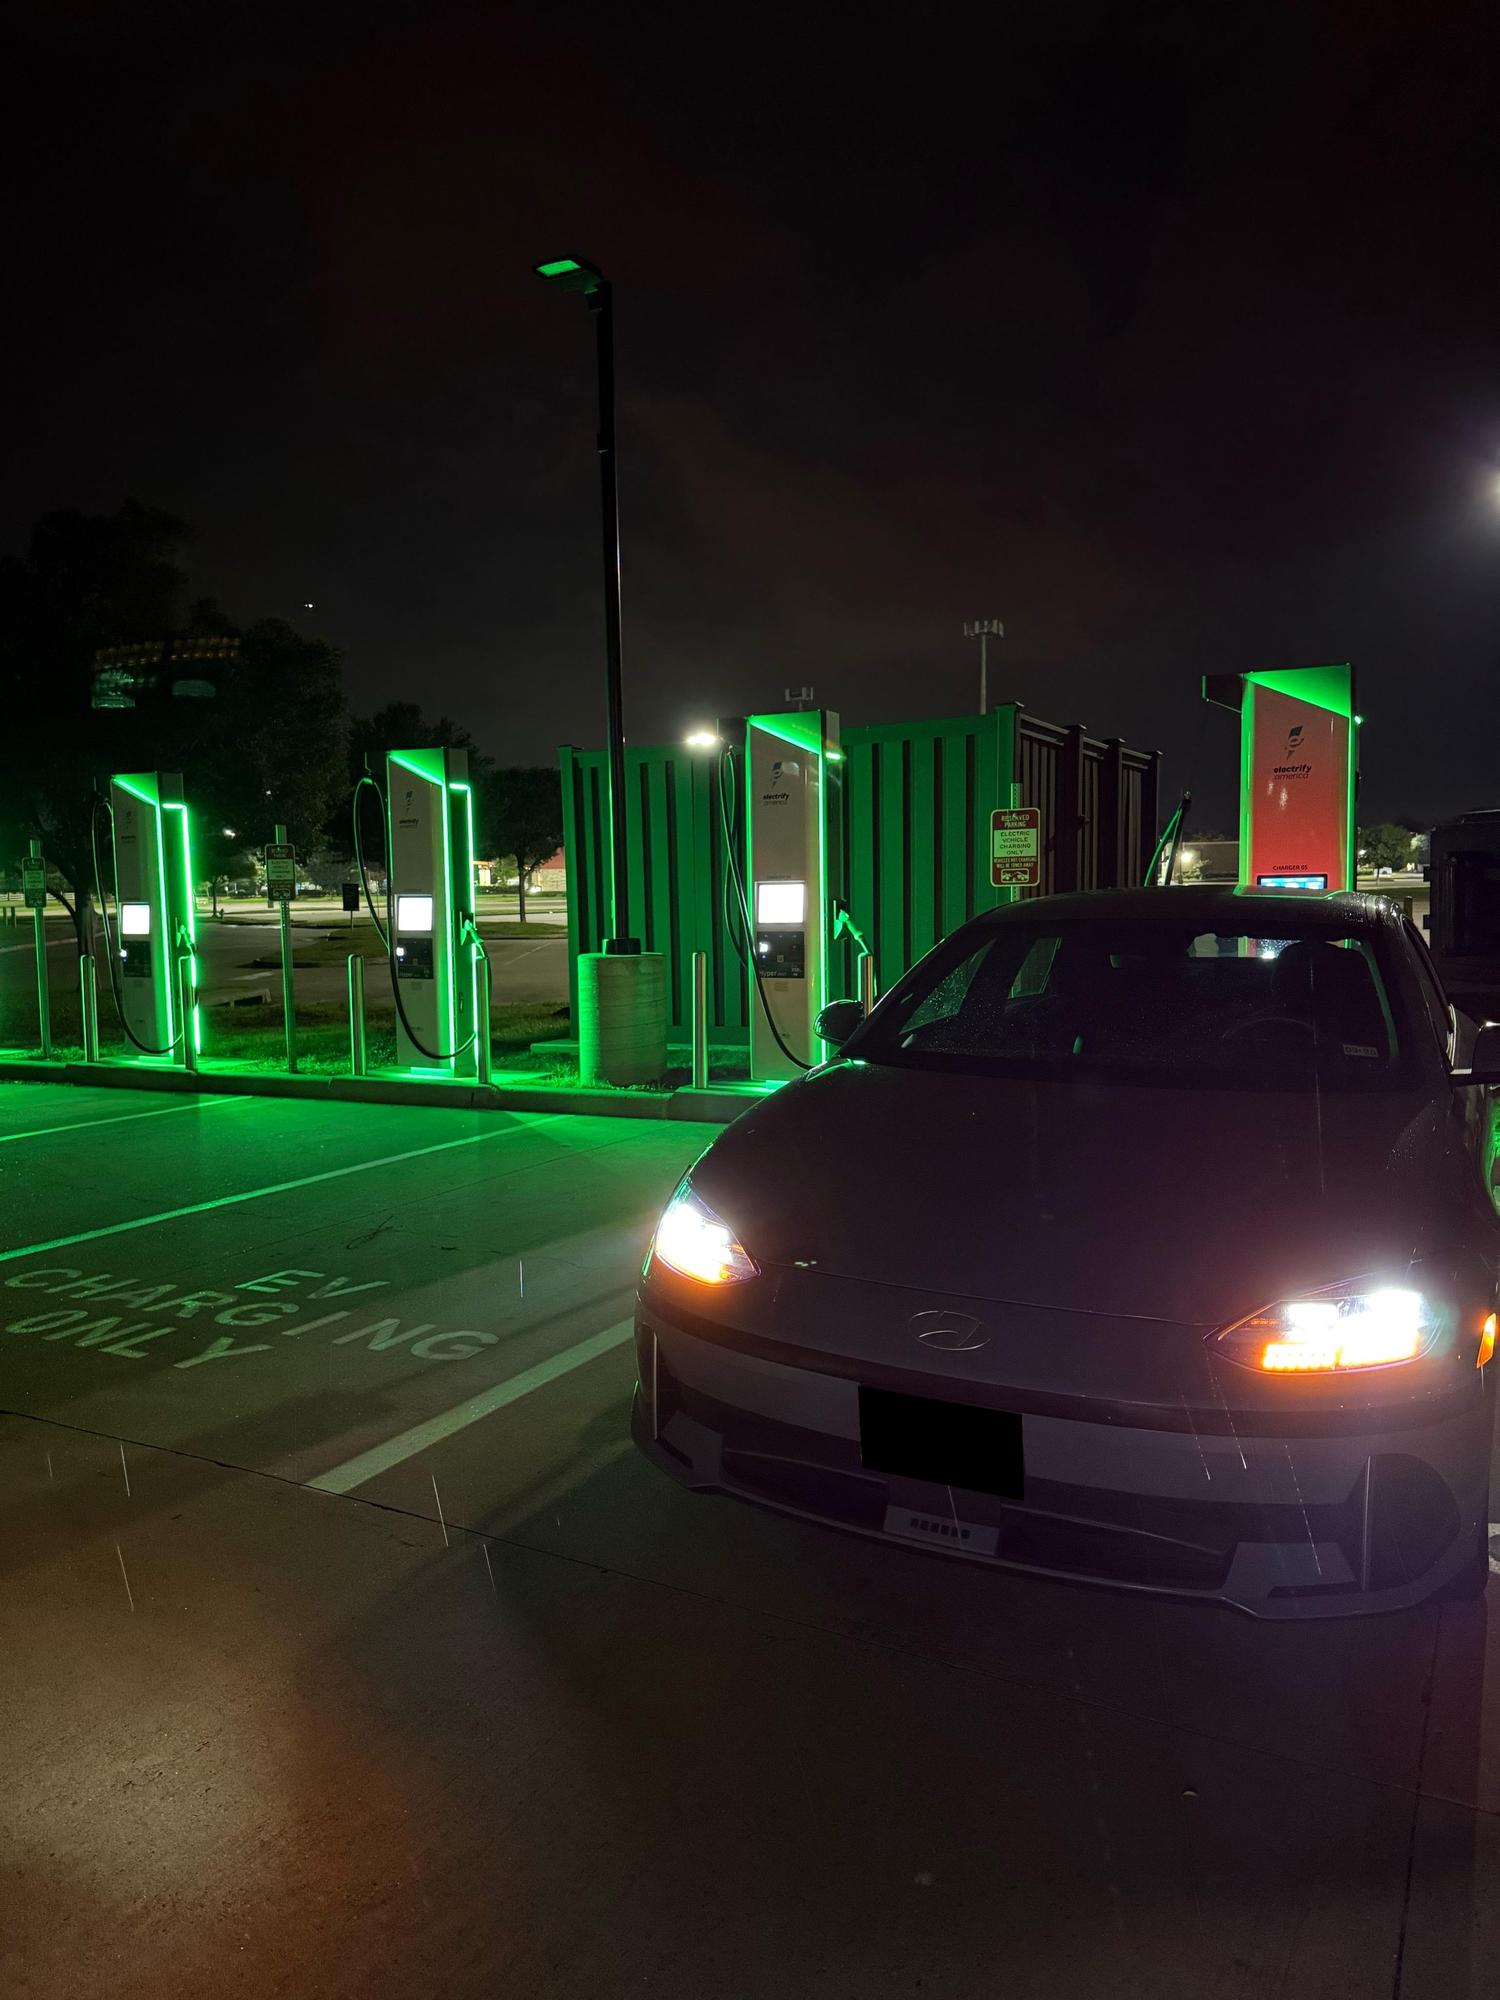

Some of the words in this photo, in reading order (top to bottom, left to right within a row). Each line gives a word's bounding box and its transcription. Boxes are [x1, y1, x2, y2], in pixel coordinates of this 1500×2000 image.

[1273, 764, 1312, 774] electrify
[763, 793, 790, 801] electrify
[233, 1268, 391, 1300] EV
[3, 1267, 500, 1361] CHARGING
[4, 1309, 276, 1370] ONLY
